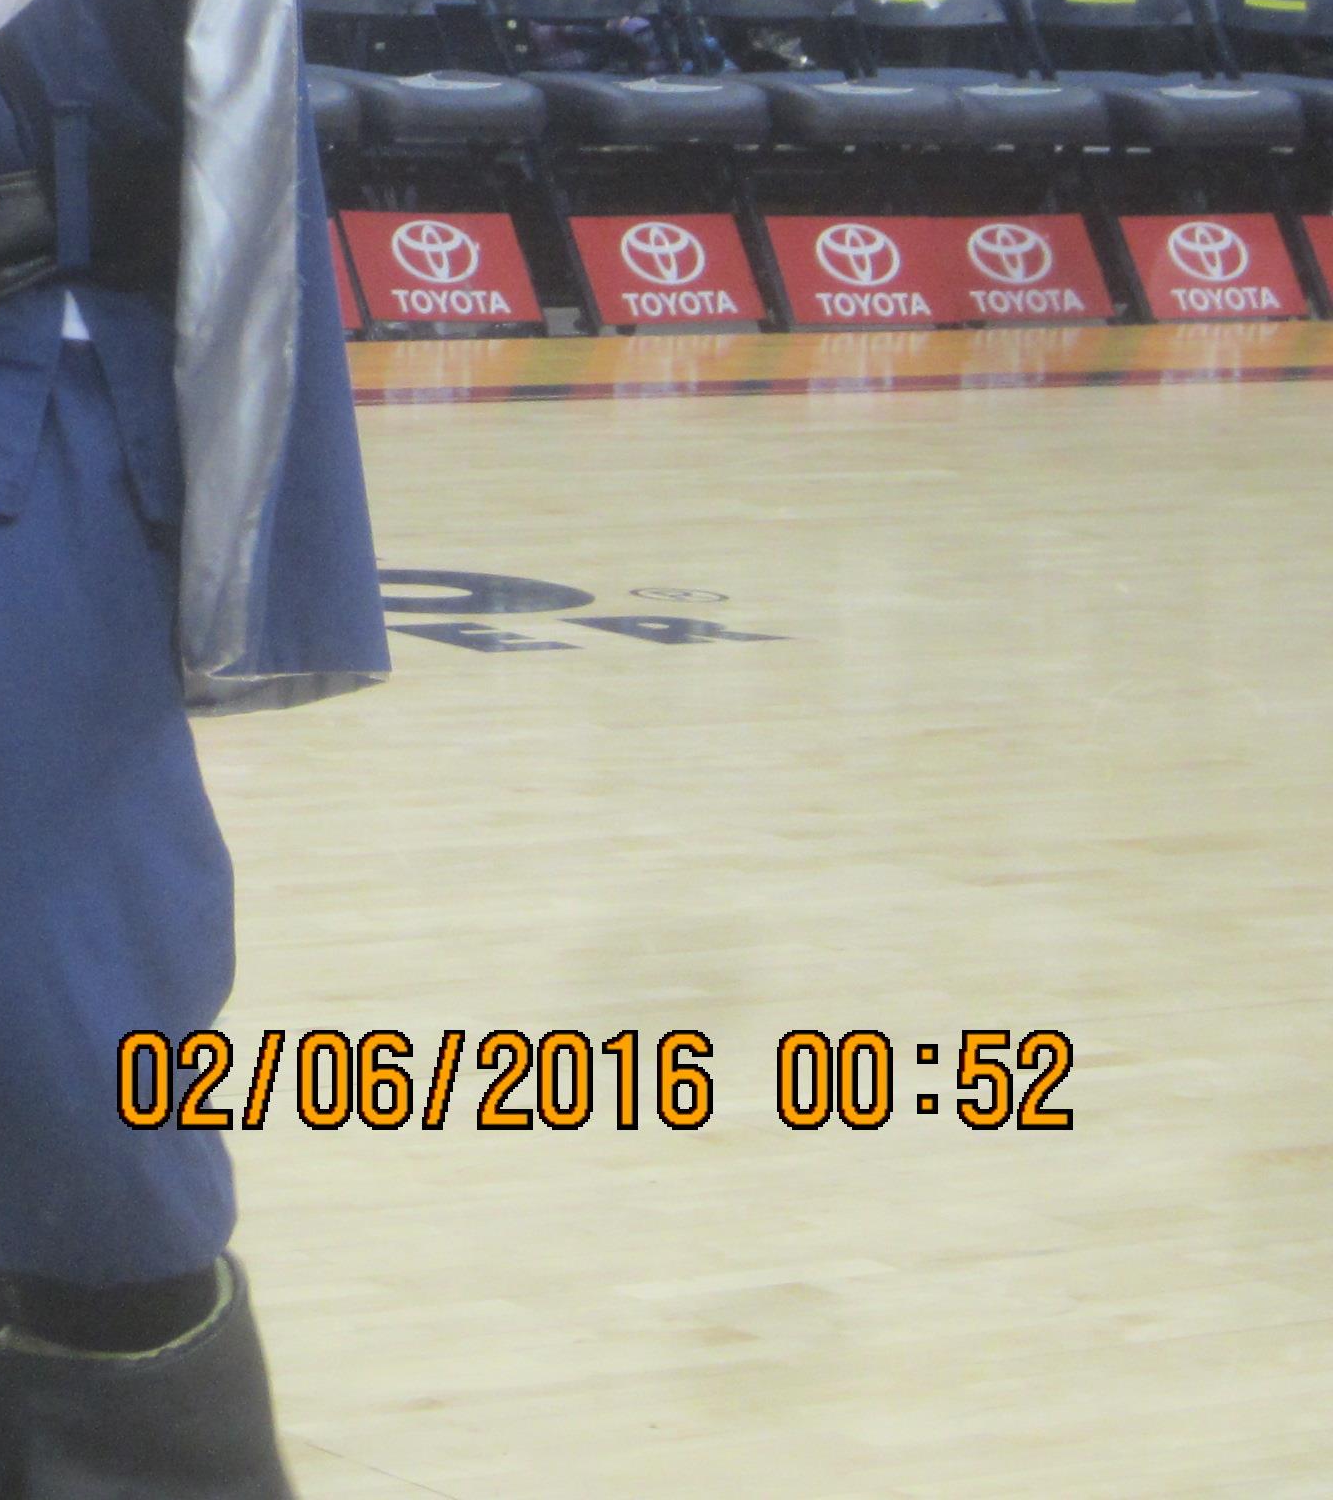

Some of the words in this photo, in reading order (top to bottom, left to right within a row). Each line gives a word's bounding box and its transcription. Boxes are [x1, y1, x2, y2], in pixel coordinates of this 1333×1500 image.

[391, 288, 512, 315] TOYOTA
[622, 289, 738, 317] TOYOTA
[815, 291, 932, 317] TOYOTA
[969, 289, 1085, 315] TOYOTA
[1171, 286, 1282, 312] TOYOTA
